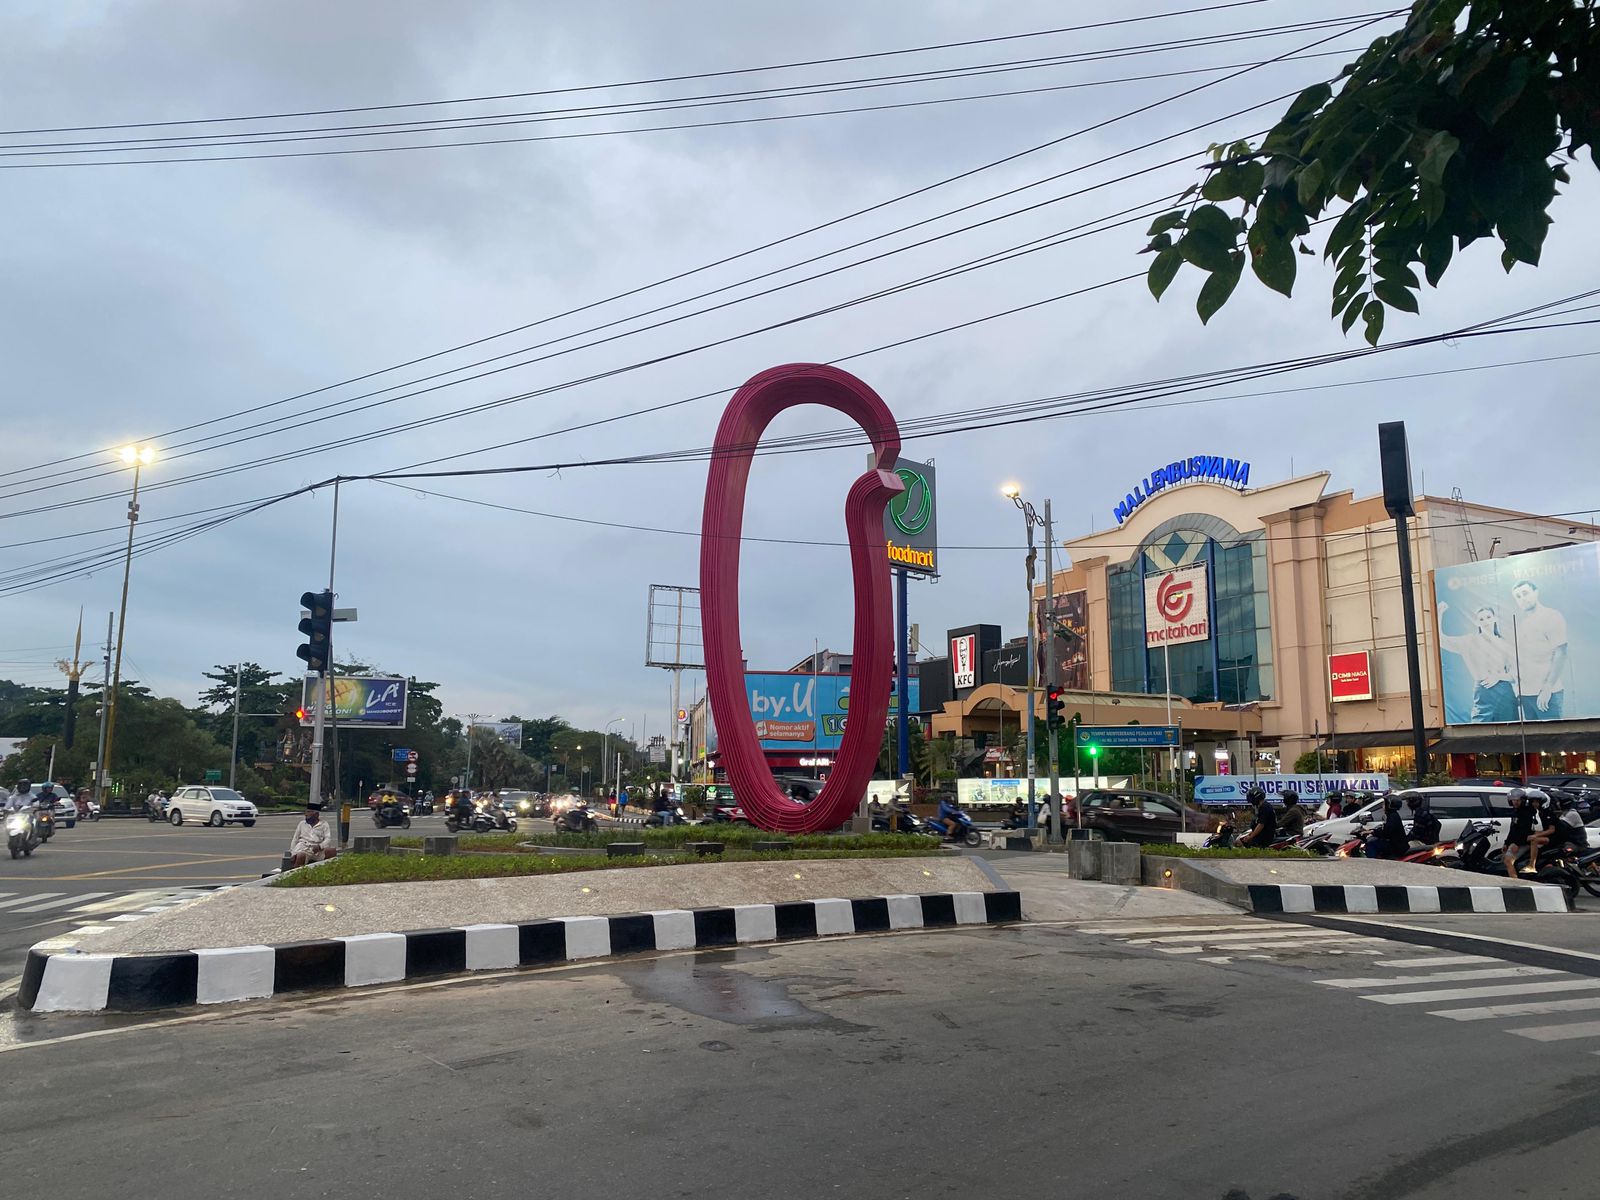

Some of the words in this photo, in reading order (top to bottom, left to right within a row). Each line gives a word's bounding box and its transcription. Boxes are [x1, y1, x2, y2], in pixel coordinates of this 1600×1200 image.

[1113, 486, 1147, 524] MAL
[1142, 455, 1251, 497] LEMBUSWANA
[886, 540, 935, 568] foodmart
[1147, 618, 1207, 643] matahari
[957, 674, 973, 686] KFC
[752, 678, 815, 718] by.U
[769, 724, 793, 732] Nomor
[794, 723, 810, 732] aktif
[769, 730, 805, 738] selamanya
[1287, 780, 1303, 794] DI
[1305, 779, 1380, 794] SEWAKAN
